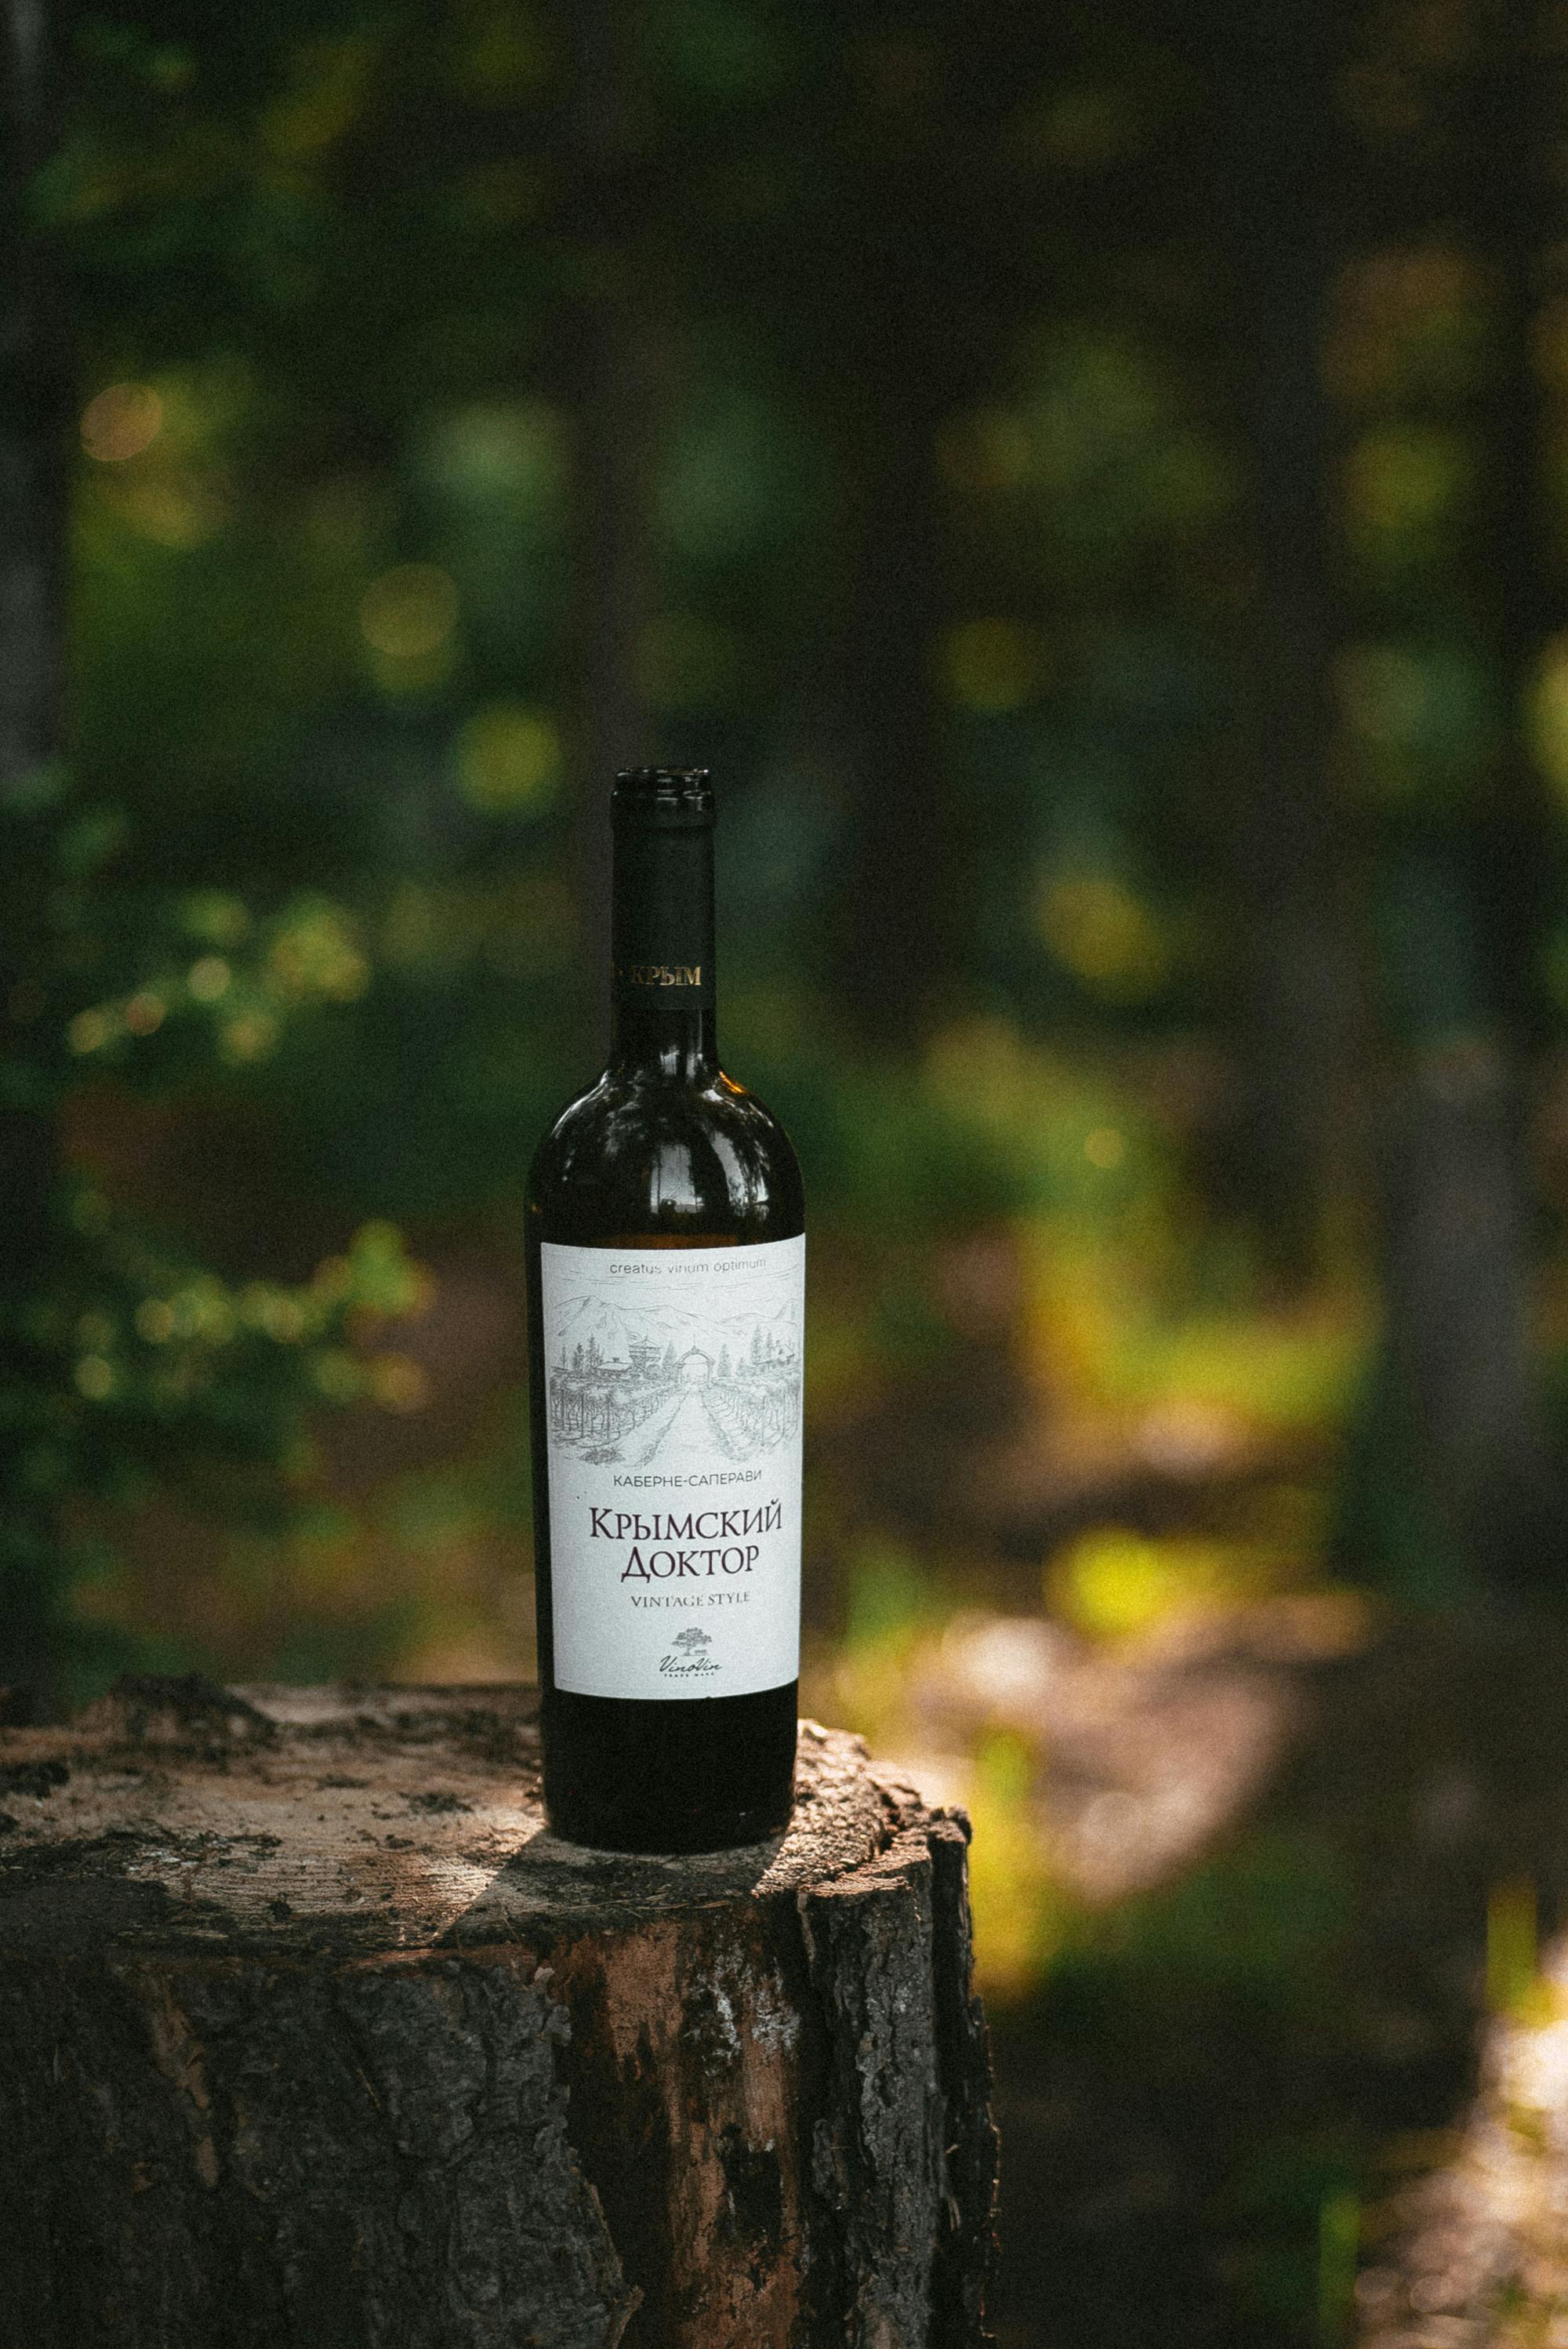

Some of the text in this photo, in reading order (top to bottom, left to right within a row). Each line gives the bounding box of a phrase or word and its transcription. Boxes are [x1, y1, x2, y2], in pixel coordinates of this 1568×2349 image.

[629, 966, 702, 986] КРЫМ
[609, 1258, 766, 1274] creatus vinum optimum
[613, 1469, 762, 1487] КАБЕРНЕ-САПЕРАВИ
[589, 1498, 782, 1541] КРЫМСКИЙ
[620, 1545, 760, 1583] ДОКТОР
[630, 1592, 751, 1607] VINTAGE STYLE
